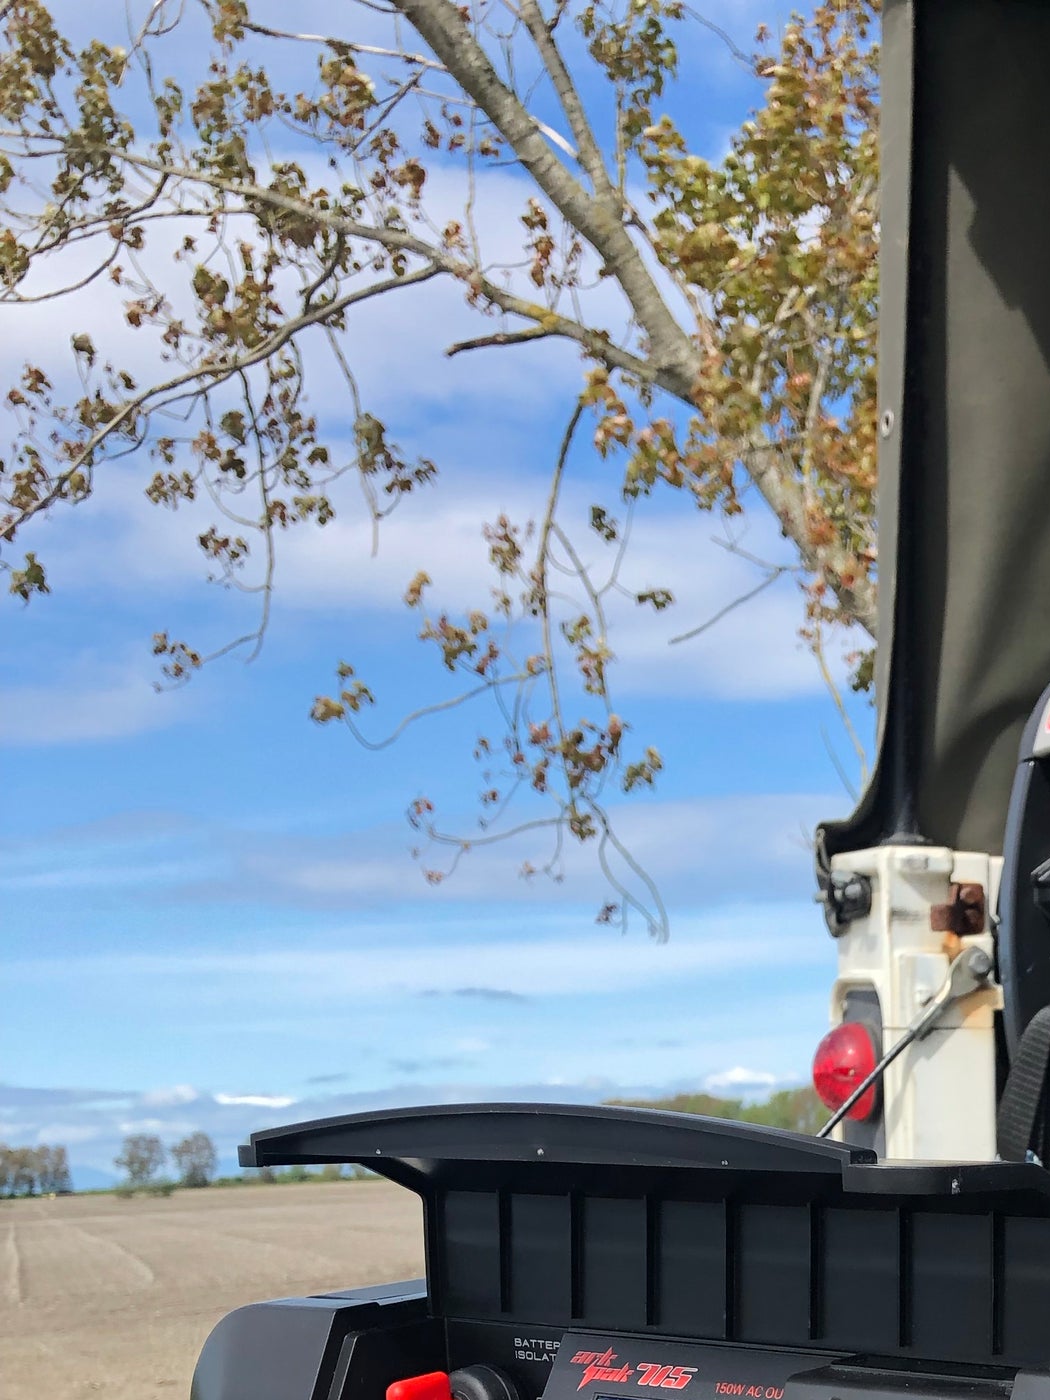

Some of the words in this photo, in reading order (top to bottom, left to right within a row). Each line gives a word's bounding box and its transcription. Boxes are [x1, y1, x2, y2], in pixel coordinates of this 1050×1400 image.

[515, 1350, 557, 1362] ISOLAT
[570, 1346, 618, 1366] ark
[636, 1362, 699, 1390] 715
[715, 1382, 746, 1396] 150W
[746, 1385, 763, 1398] AC
